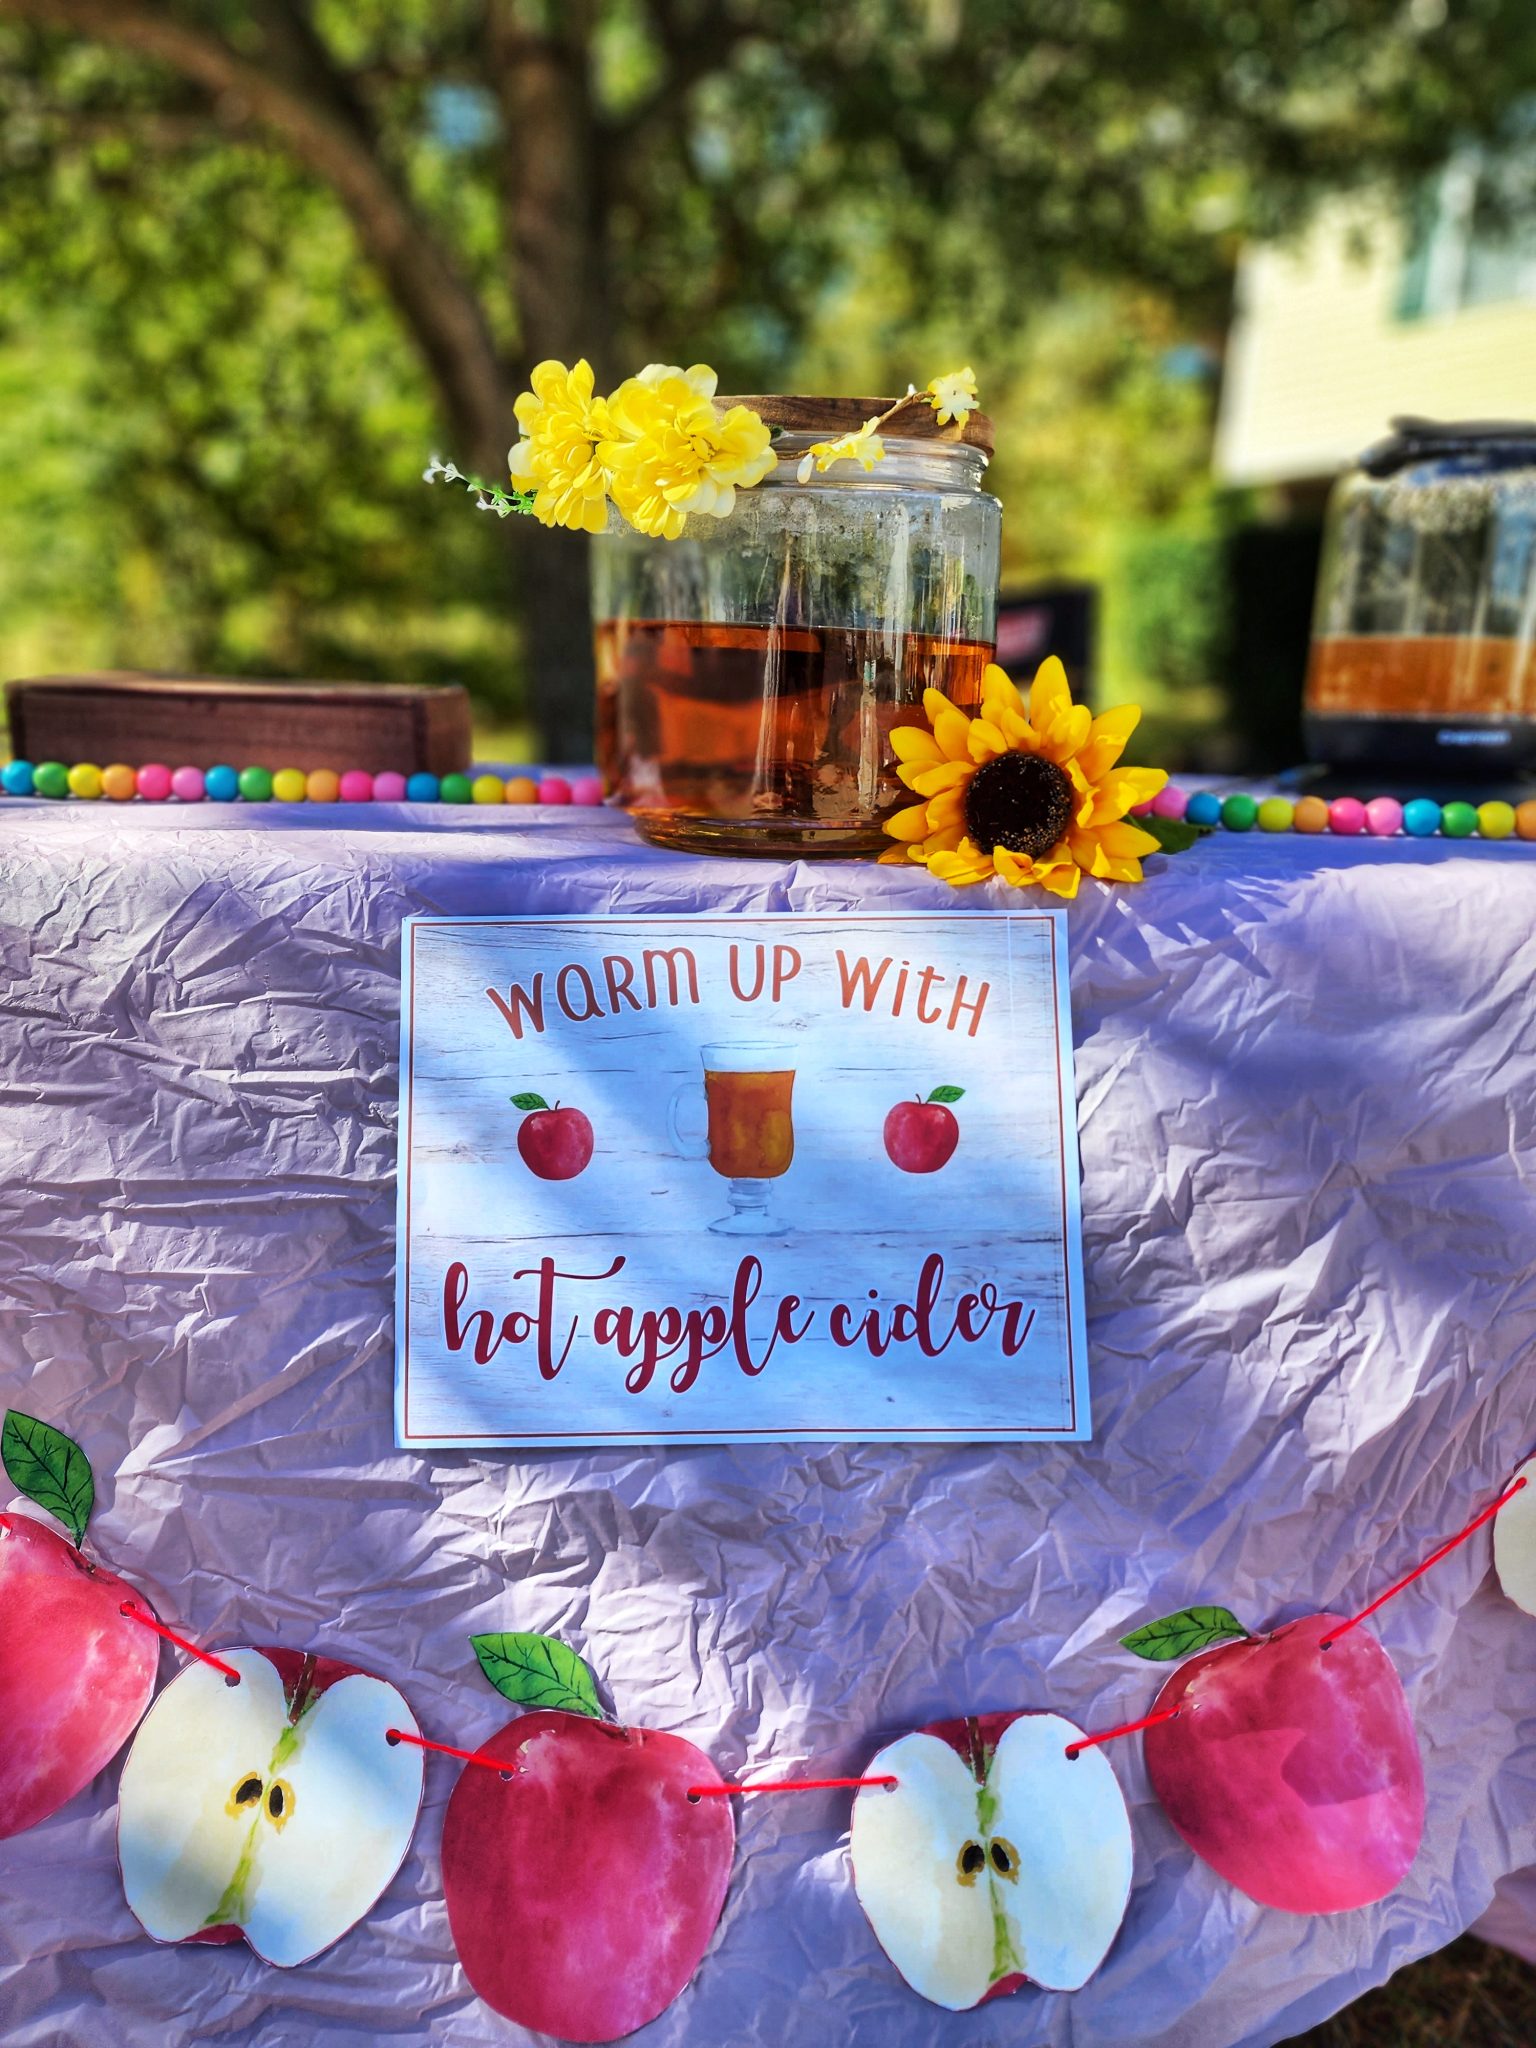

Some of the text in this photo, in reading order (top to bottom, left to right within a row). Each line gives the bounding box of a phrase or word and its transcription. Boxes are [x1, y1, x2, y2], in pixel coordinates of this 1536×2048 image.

[729, 943, 802, 1003] UP
[445, 1252, 1036, 1394] hot apple cider
